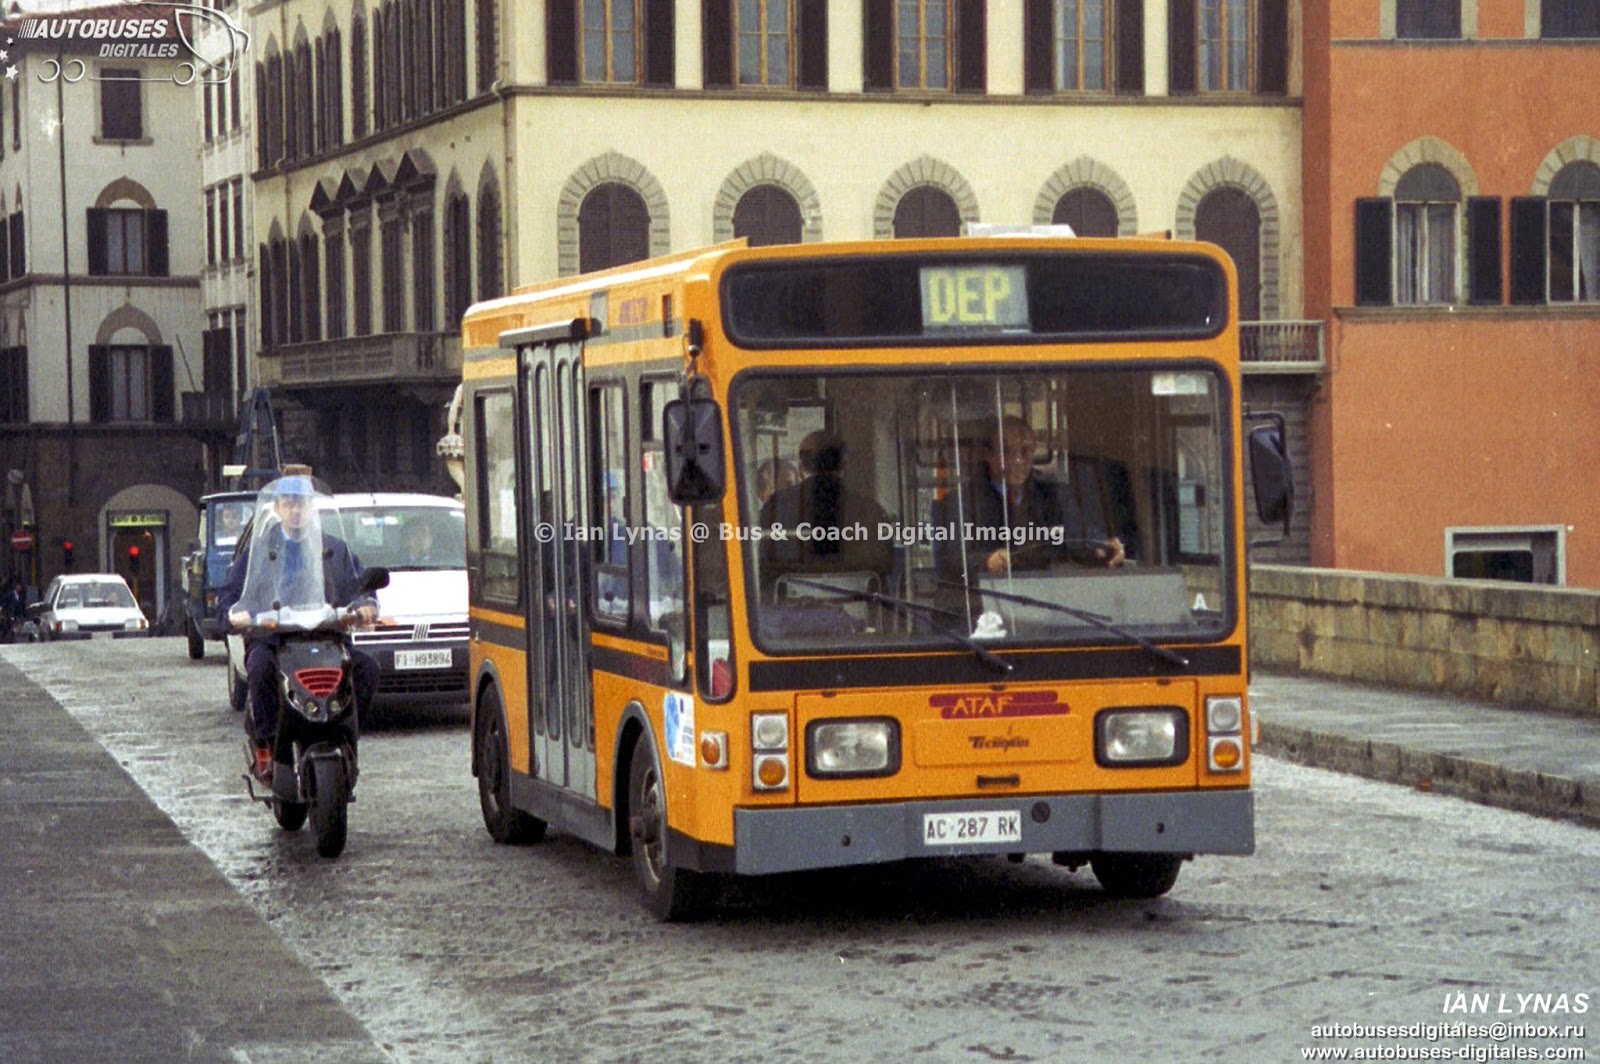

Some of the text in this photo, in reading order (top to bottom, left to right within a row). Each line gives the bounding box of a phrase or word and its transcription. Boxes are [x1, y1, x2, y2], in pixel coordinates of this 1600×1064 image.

[929, 269, 1010, 324] DEP
[952, 697, 1013, 715] ATAF
[927, 816, 1018, 839] AC 287 RK
